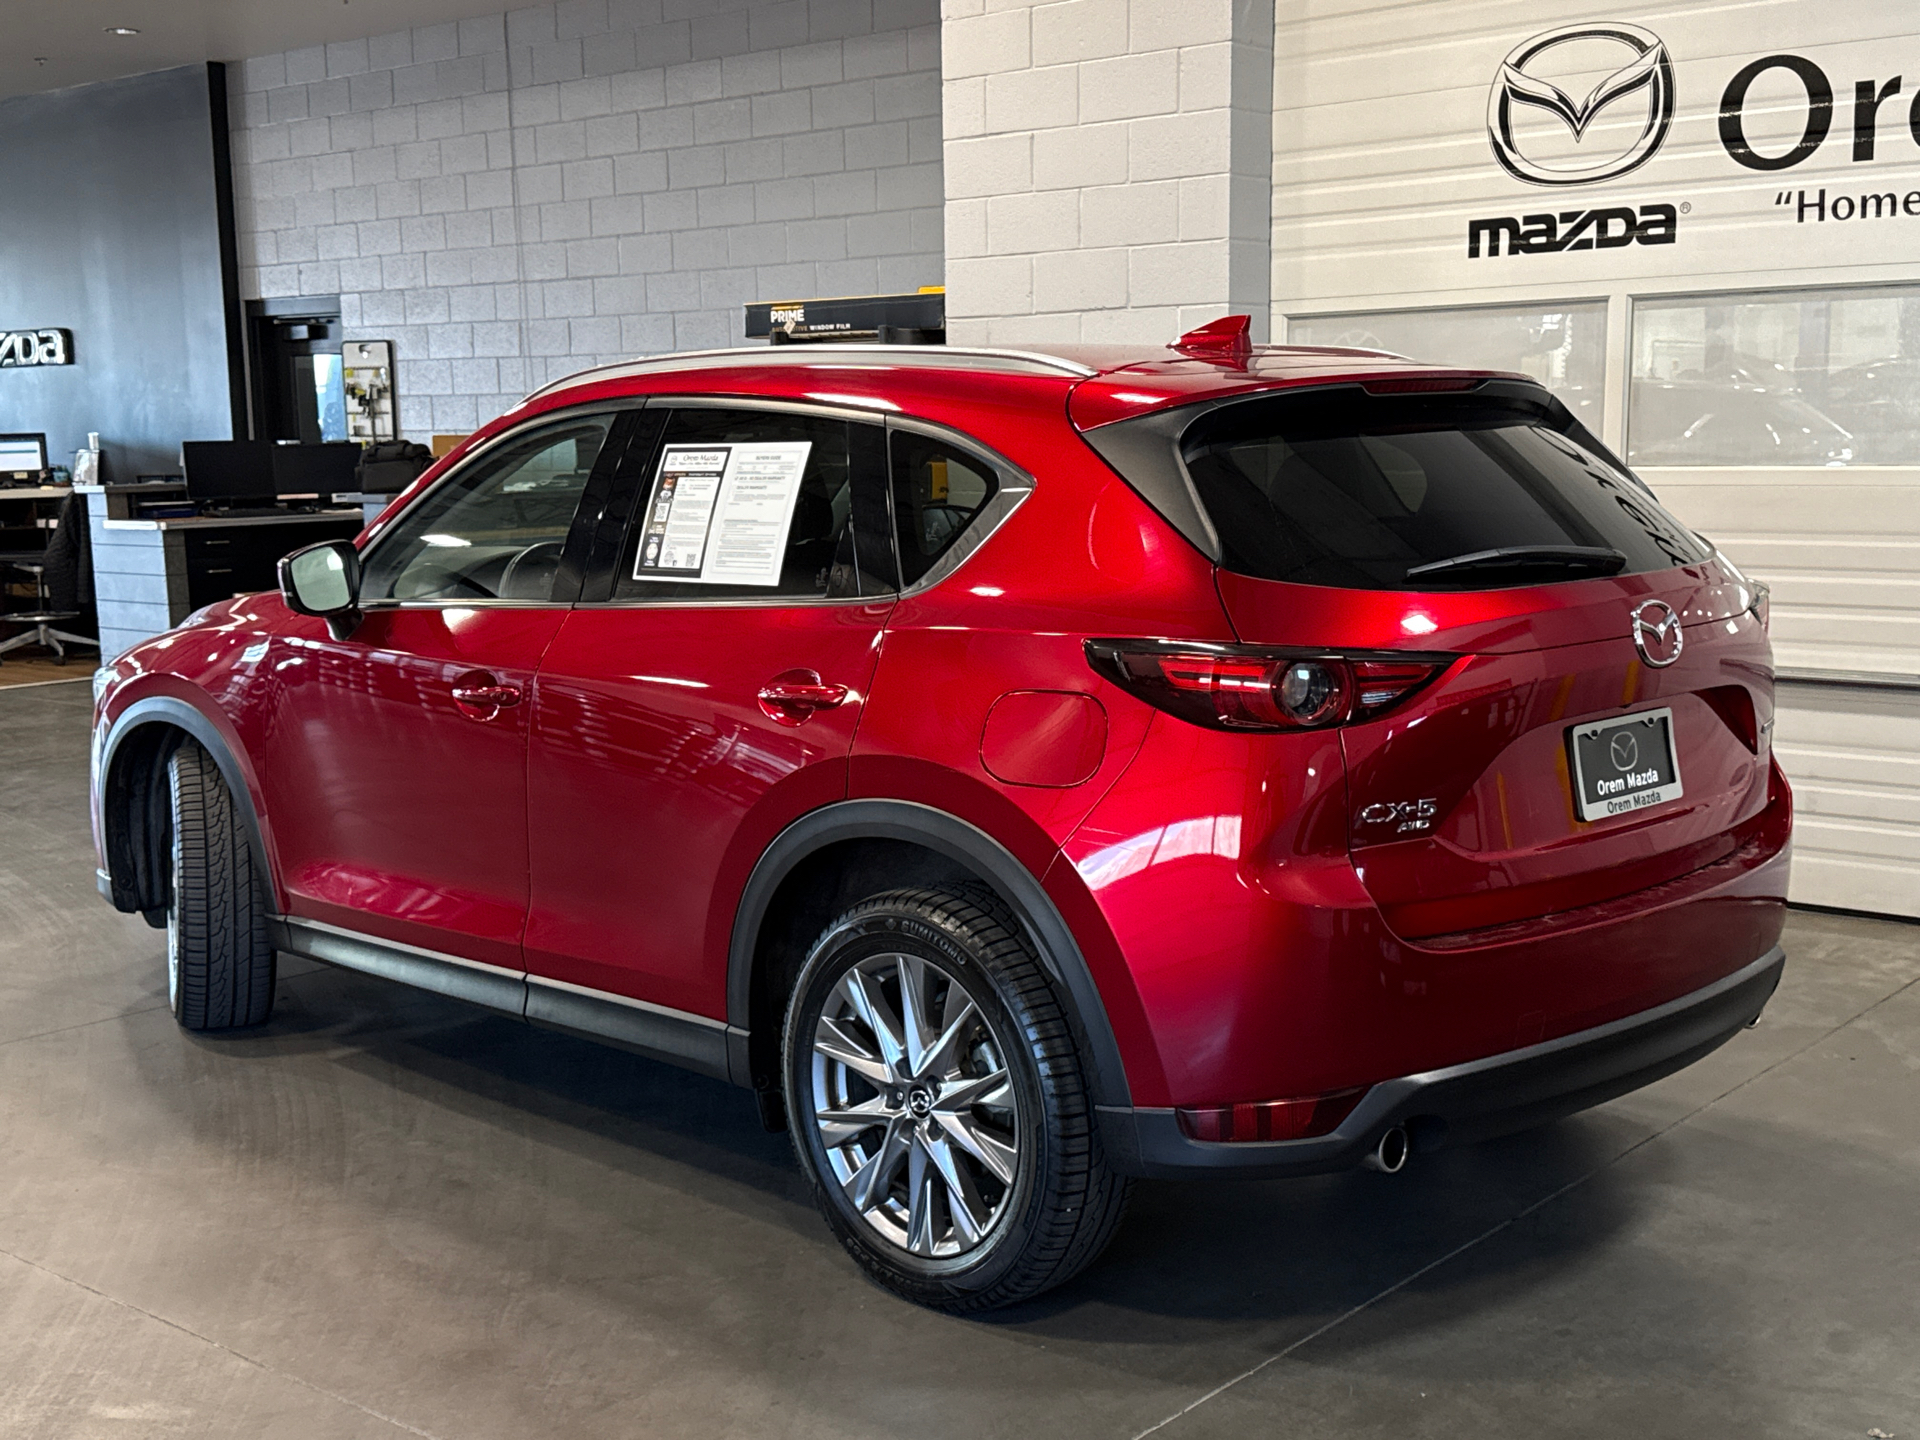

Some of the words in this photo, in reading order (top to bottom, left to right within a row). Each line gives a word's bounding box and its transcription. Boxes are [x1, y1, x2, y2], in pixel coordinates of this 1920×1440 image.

[1718, 54, 1920, 171] Or
[1468, 203, 1677, 259] mazda
[770, 309, 805, 323] PRIME
[1597, 778, 1625, 796] Orem
[1626, 767, 1659, 789] Mazda
[1362, 797, 1437, 823] CX-5
[1607, 799, 1632, 814] Orem
[1633, 791, 1662, 808] Mazda
[901, 920, 967, 966] SUMITOMO
